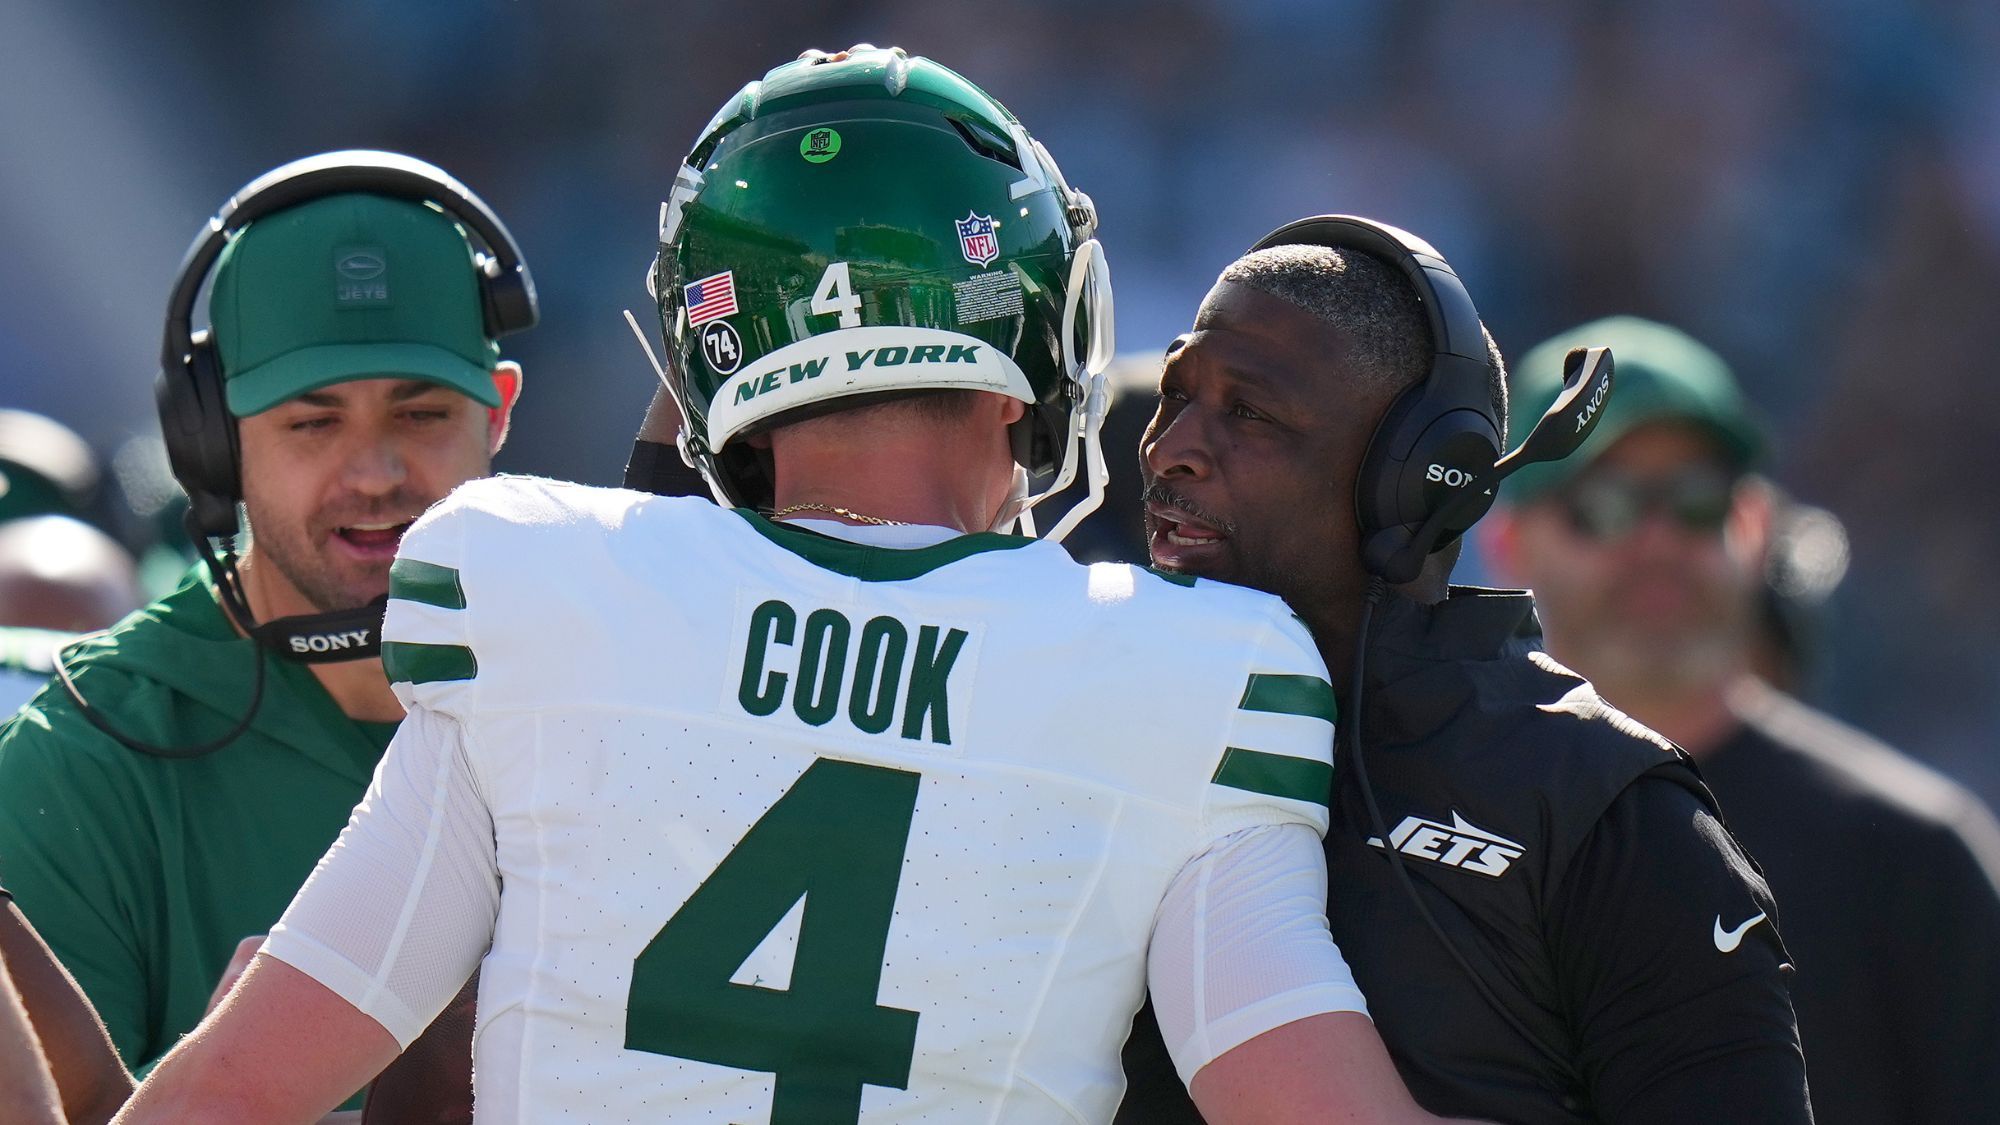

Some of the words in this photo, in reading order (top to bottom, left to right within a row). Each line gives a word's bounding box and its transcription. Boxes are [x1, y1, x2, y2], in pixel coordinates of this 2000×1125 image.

[966, 236, 994, 258] NFL
[968, 270, 1003, 280] WARNING
[811, 262, 862, 328] 4
[706, 330, 737, 364] 74
[734, 356, 829, 406] NEW
[846, 345, 981, 372] YORK
[1575, 373, 1609, 433] SONY
[289, 629, 370, 653] SONY
[738, 600, 968, 745] COOK
[1366, 810, 1527, 877] JETS
[624, 756, 921, 1125] 4
